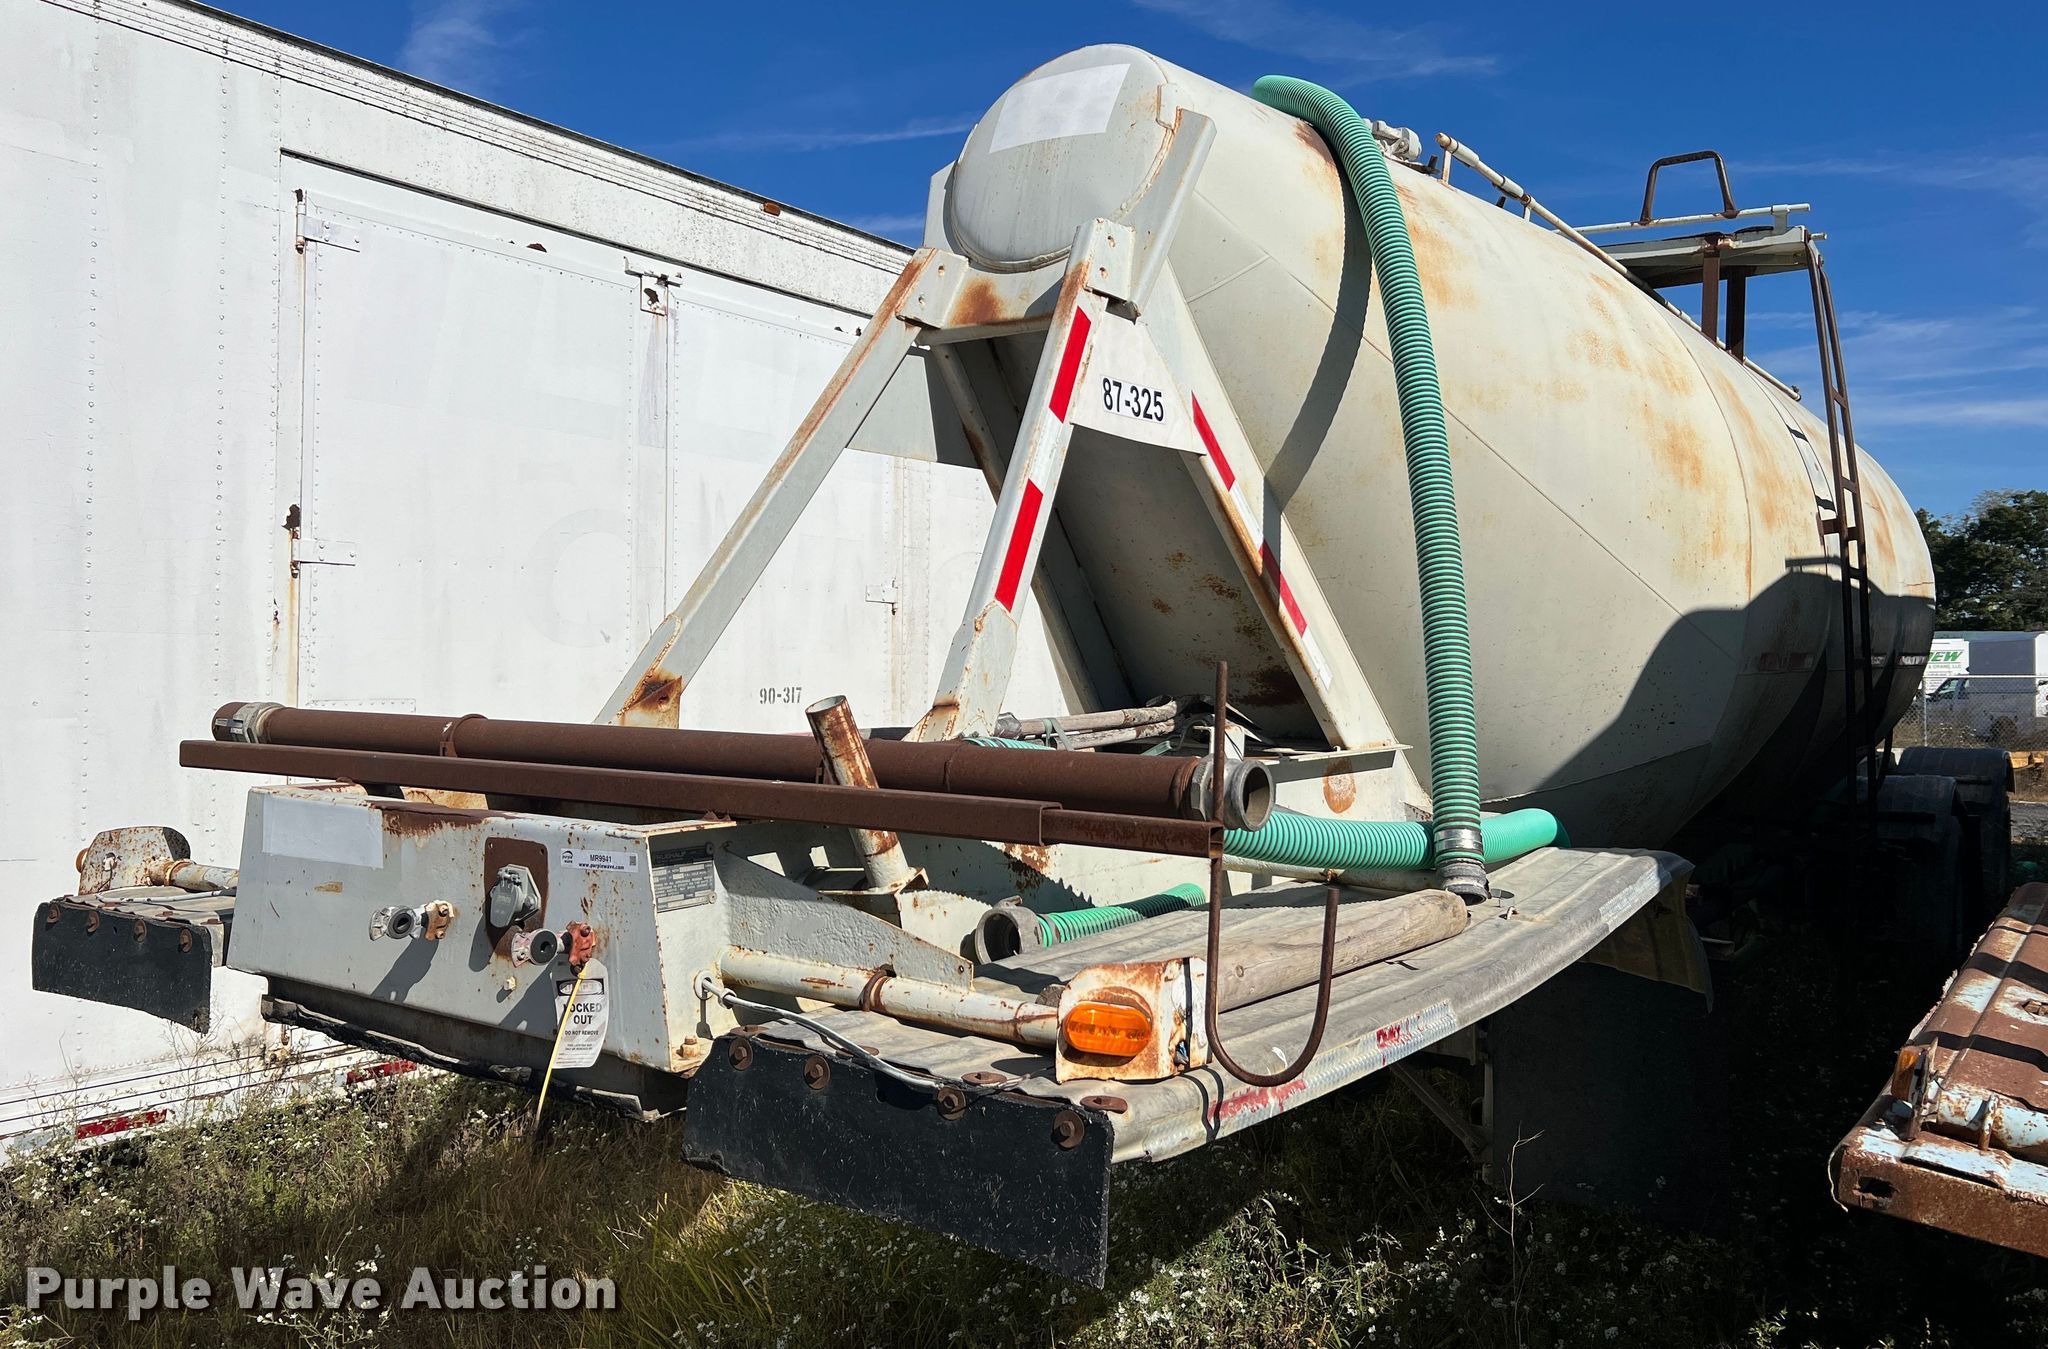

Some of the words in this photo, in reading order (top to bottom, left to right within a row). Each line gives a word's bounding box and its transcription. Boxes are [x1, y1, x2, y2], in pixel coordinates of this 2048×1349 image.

[1102, 377, 1165, 422] 87-325
[760, 687, 802, 705] 90-317
[573, 1014, 593, 1025] OUT
